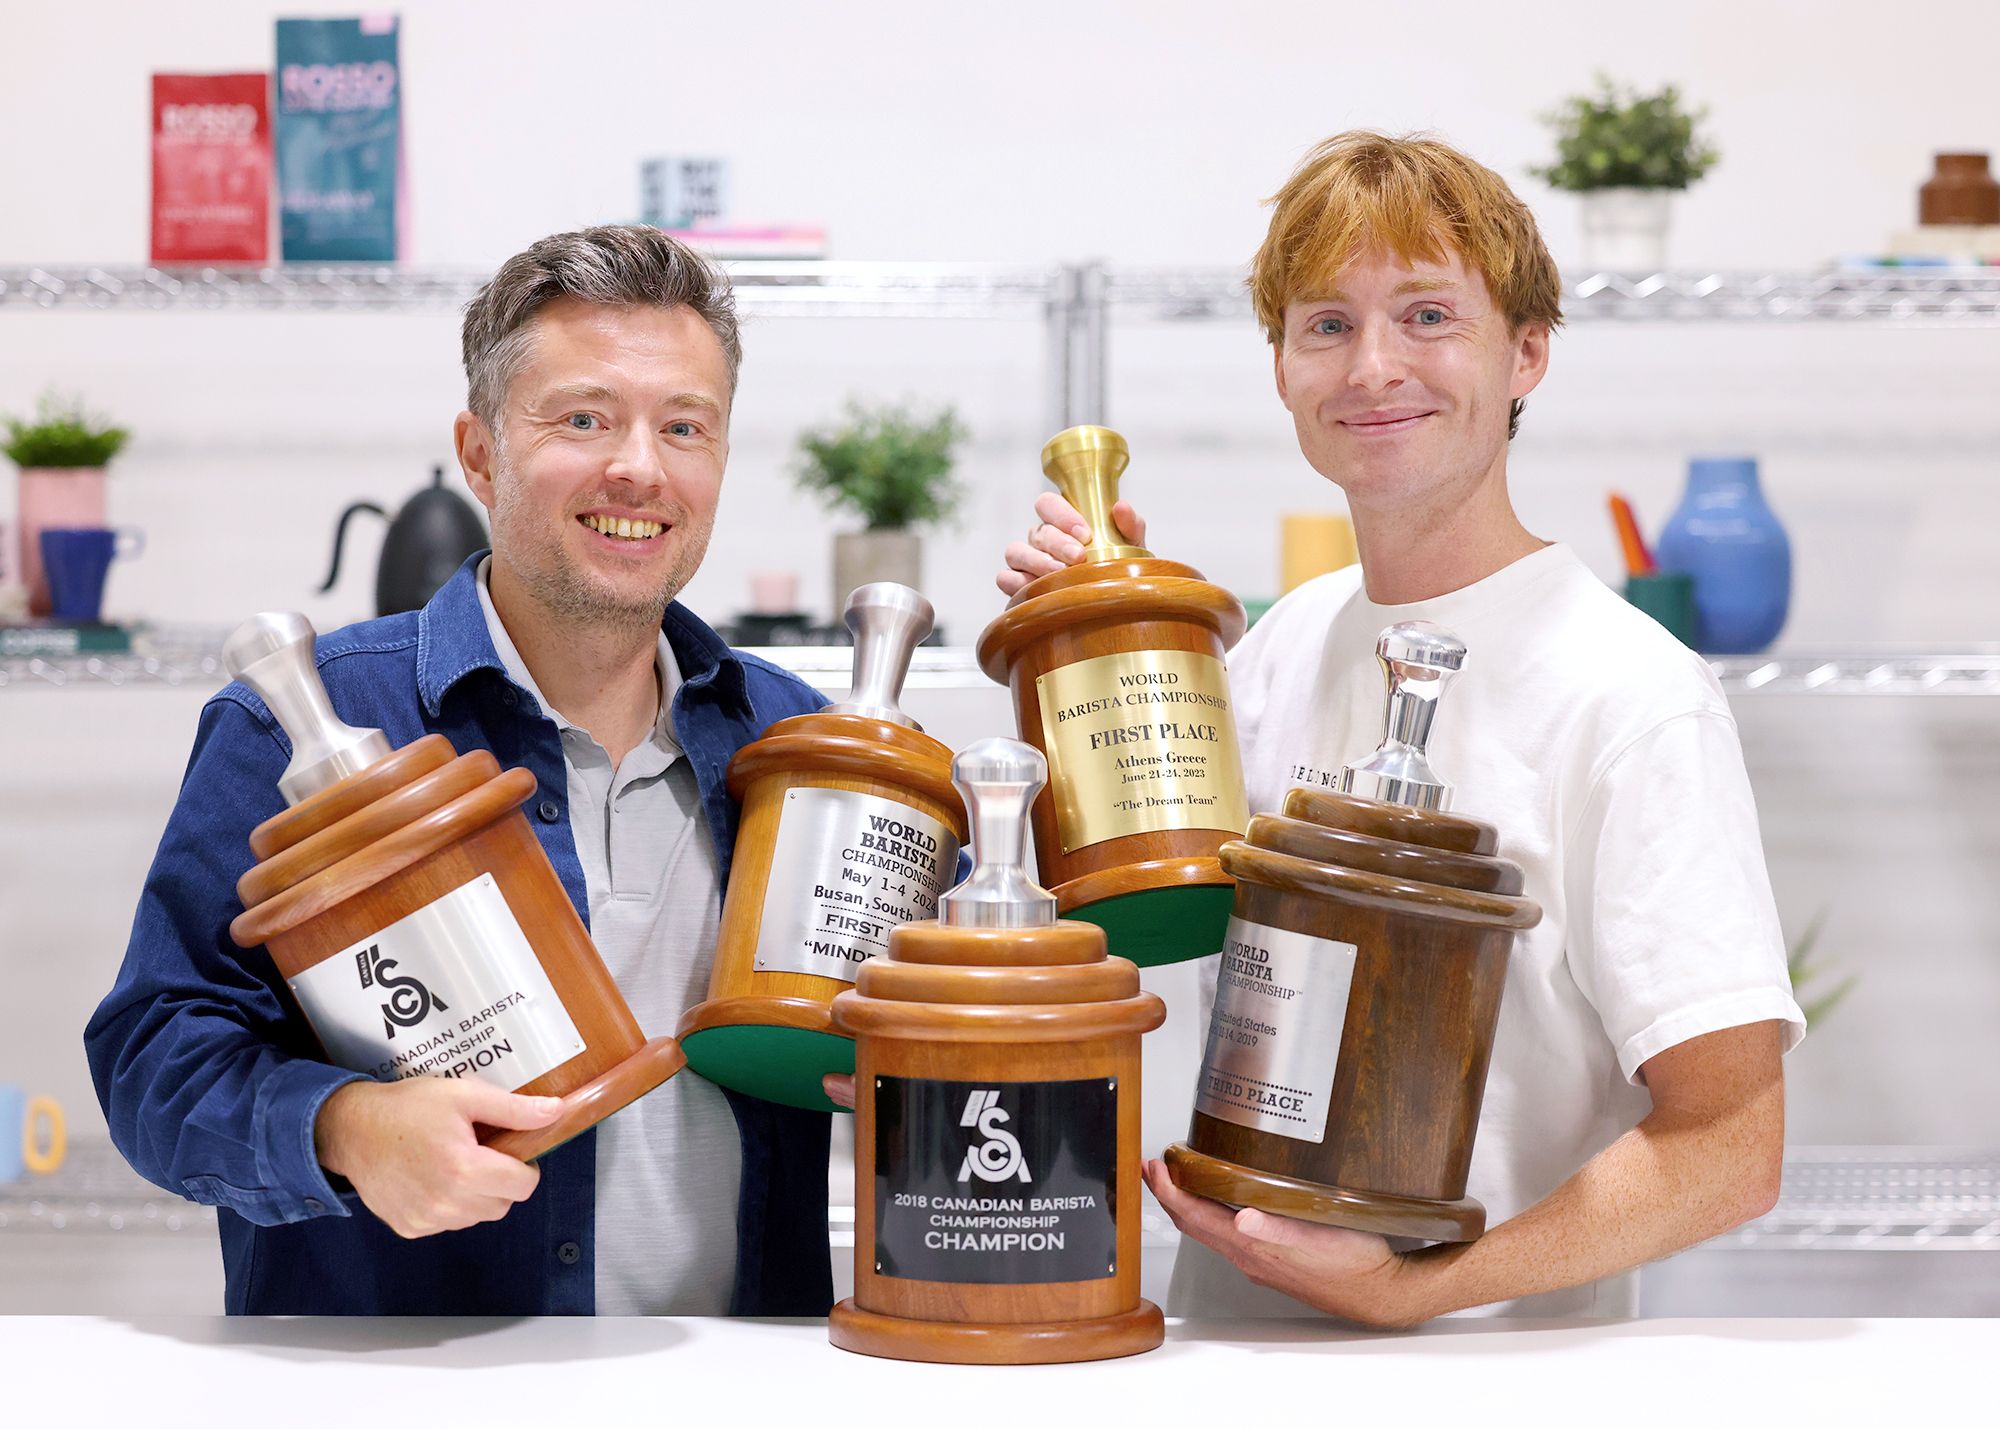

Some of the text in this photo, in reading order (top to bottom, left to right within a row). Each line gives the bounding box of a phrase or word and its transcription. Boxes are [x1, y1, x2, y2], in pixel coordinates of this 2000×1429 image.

[1120, 672, 1178, 687] WORLD
[1057, 691, 1228, 723] BARISTA CHAMPIONSHIP
[1089, 723, 1218, 750] FIRST PLACE
[1114, 751, 1207, 770] Athens Greece
[1121, 772, 1147, 784] June
[1183, 768, 1205, 779] 2023
[1146, 795, 1184, 807] Dream
[868, 814, 937, 853] WORLD
[860, 832, 937, 875] BARISTA
[842, 848, 943, 896] CHAMPIONSHIP
[842, 867, 937, 914] May 1-4 2024
[825, 913, 884, 938] FIRST
[1229, 940, 1270, 963] WORLD
[1226, 955, 1273, 981] BARISTA
[380, 991, 526, 1074] CANADIAN BARISTA
[1244, 1018, 1277, 1036] States
[394, 1026, 496, 1080] HAMPIONSHIP
[1208, 1075, 1304, 1113] THIRD PLACE
[894, 1193, 1096, 1211] 2018 CANADIAN BARISTA
[929, 1214, 1060, 1229] CHAMPIONSHIP
[924, 1231, 1065, 1251] CHAMPION
